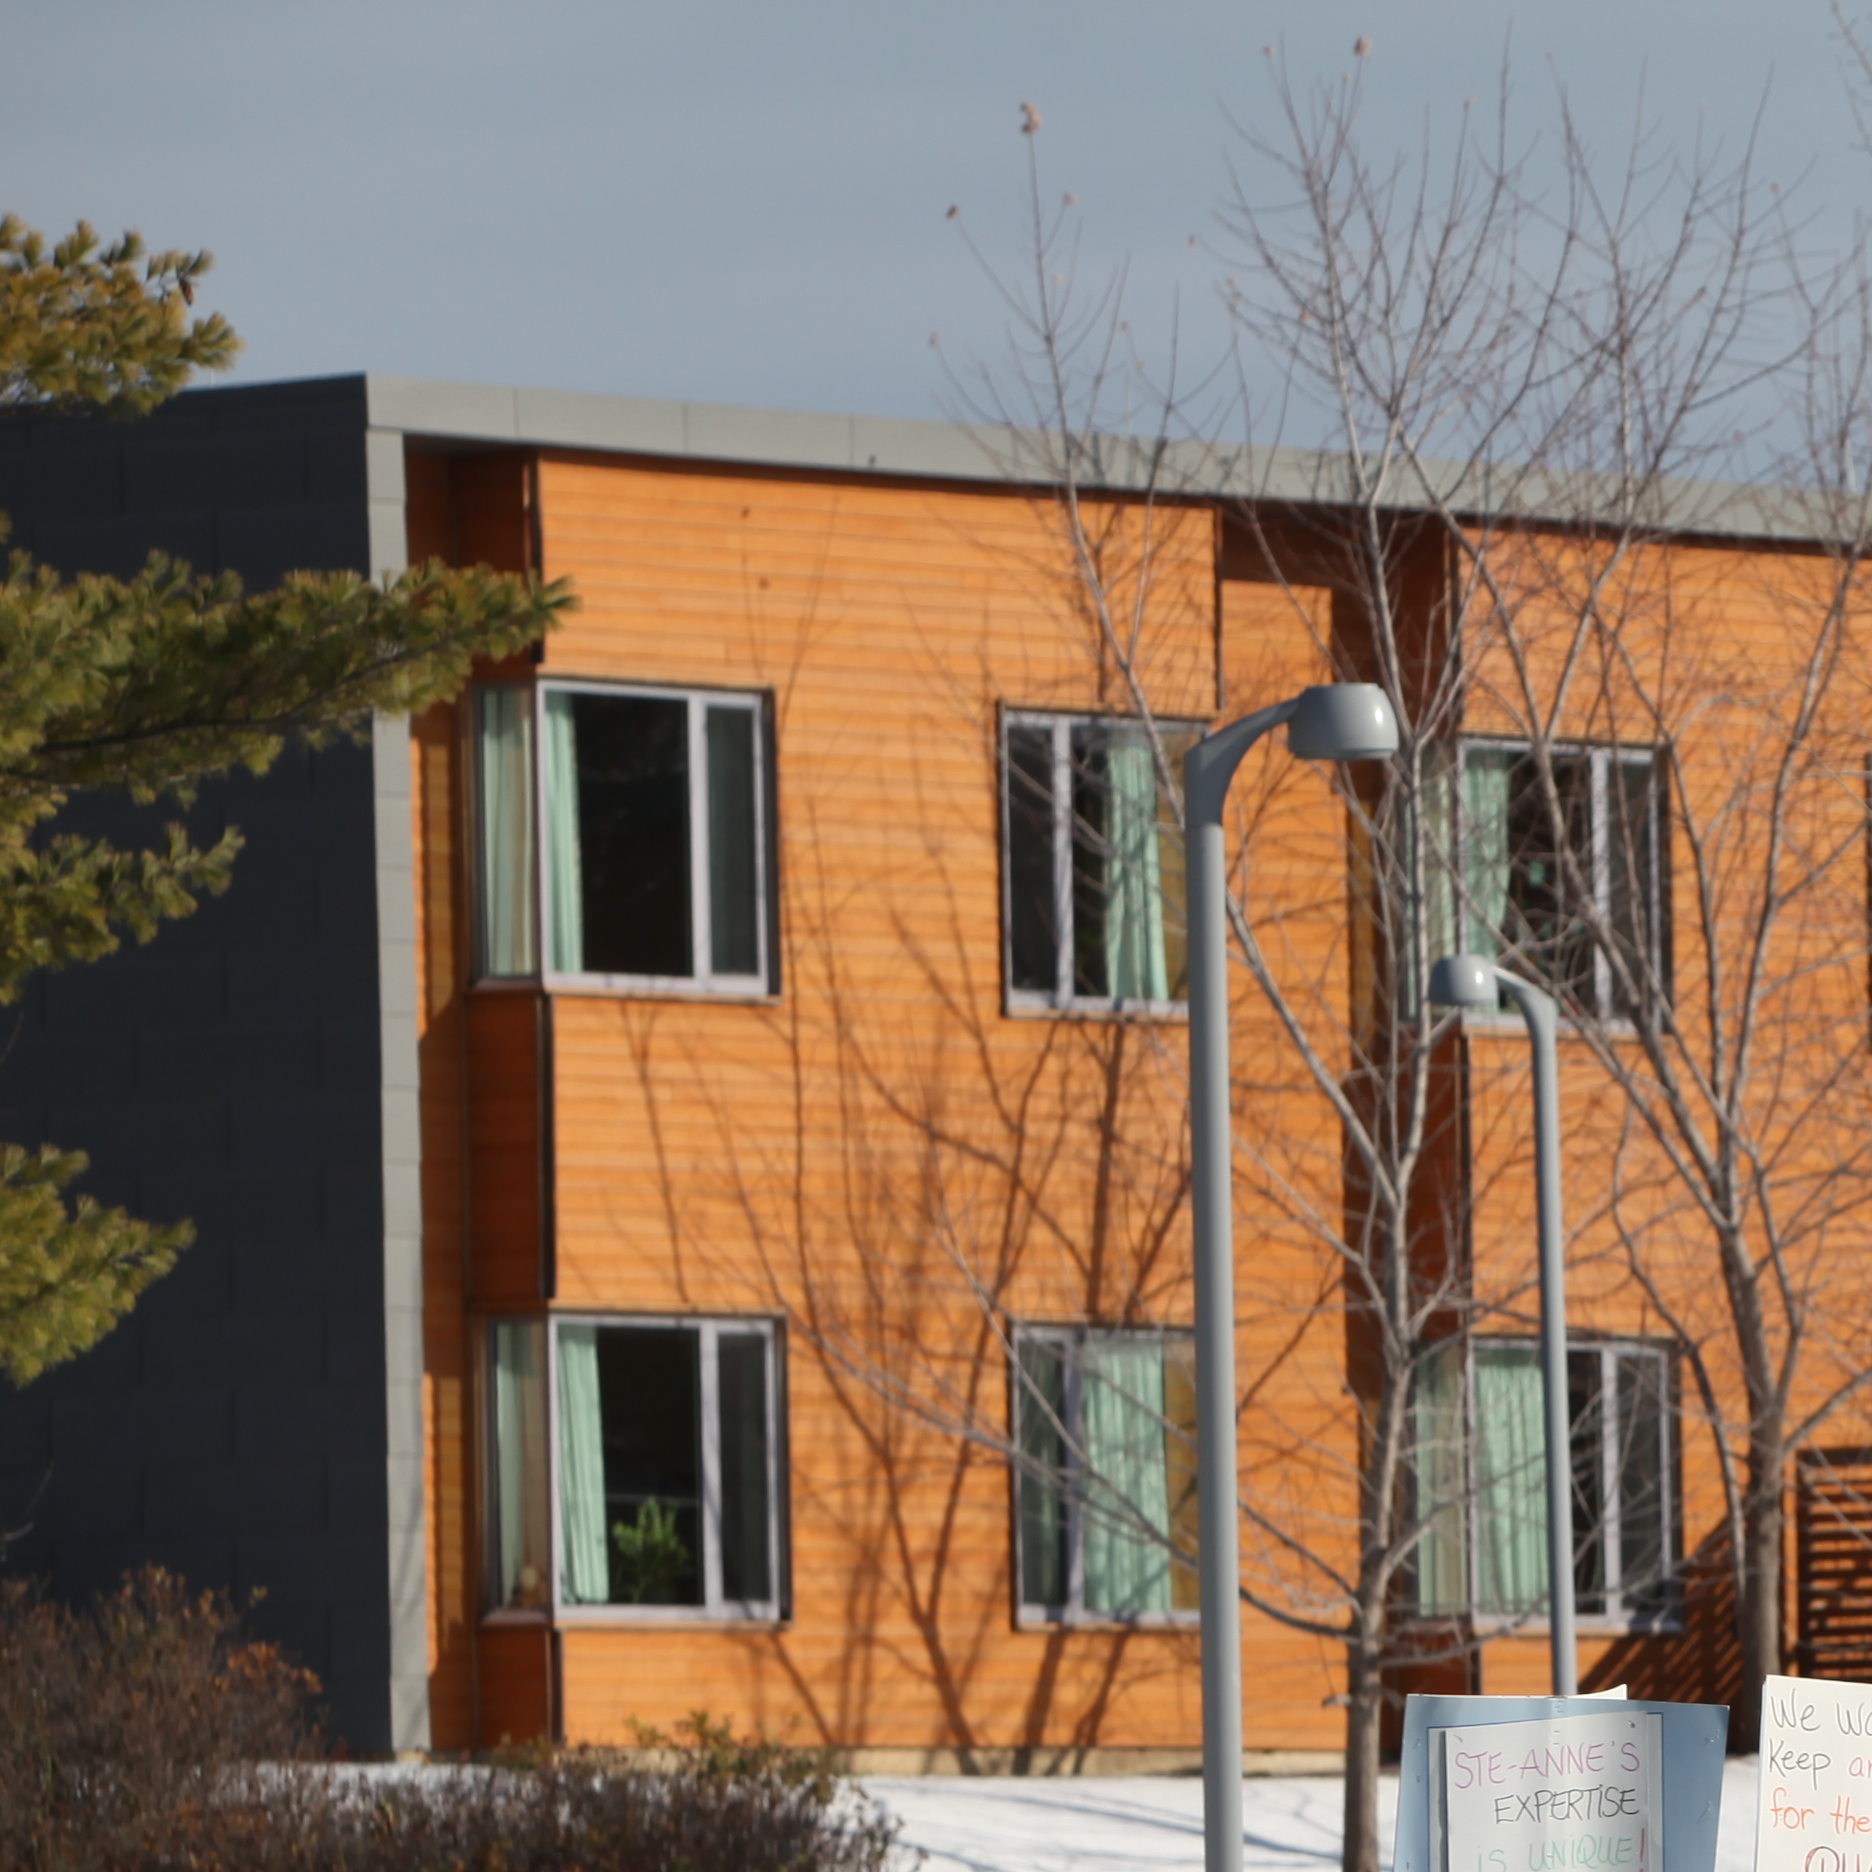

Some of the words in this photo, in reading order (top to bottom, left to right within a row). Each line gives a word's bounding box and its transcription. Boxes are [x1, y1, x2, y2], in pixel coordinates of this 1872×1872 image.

[1770, 1687, 1821, 1732] We
[1454, 1742, 1641, 1789] STE-ANNE'S
[1770, 1787, 1814, 1829] for
[1830, 1796, 1872, 1835] the
